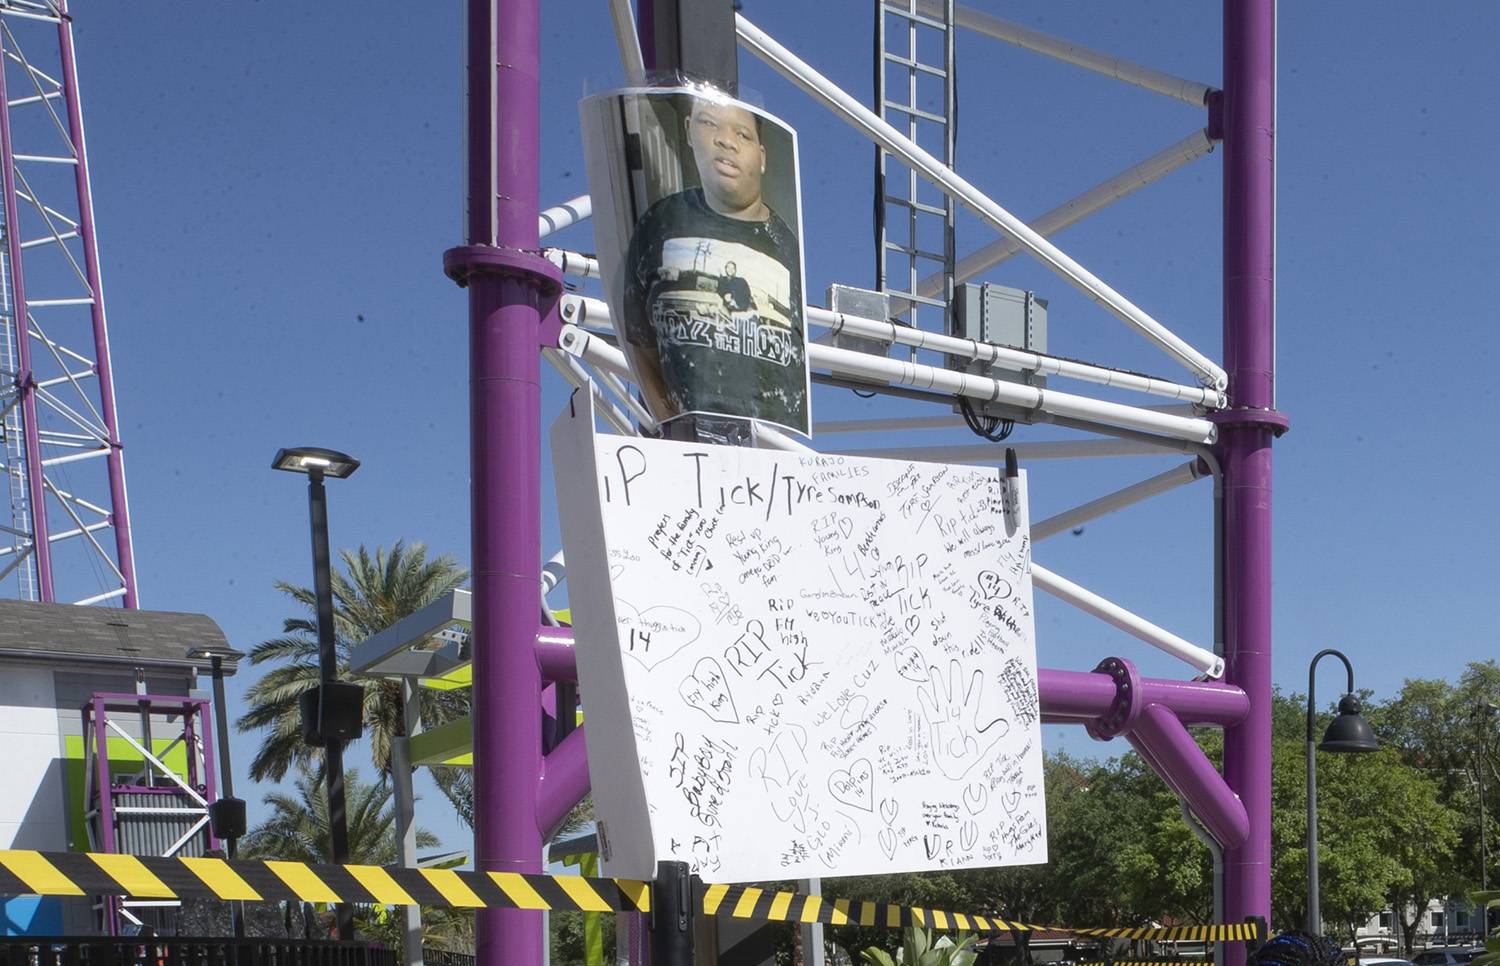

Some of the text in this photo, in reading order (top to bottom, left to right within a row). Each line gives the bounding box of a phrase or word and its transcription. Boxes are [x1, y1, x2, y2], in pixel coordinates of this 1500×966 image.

[714, 316, 792, 368] THE HOOD
[812, 465, 870, 485] FAMILIES
[810, 511, 837, 534] RIP
[894, 553, 928, 588] RIP
[630, 628, 651, 652] 14
[724, 619, 772, 678] RIP
[749, 722, 809, 793] RIP
